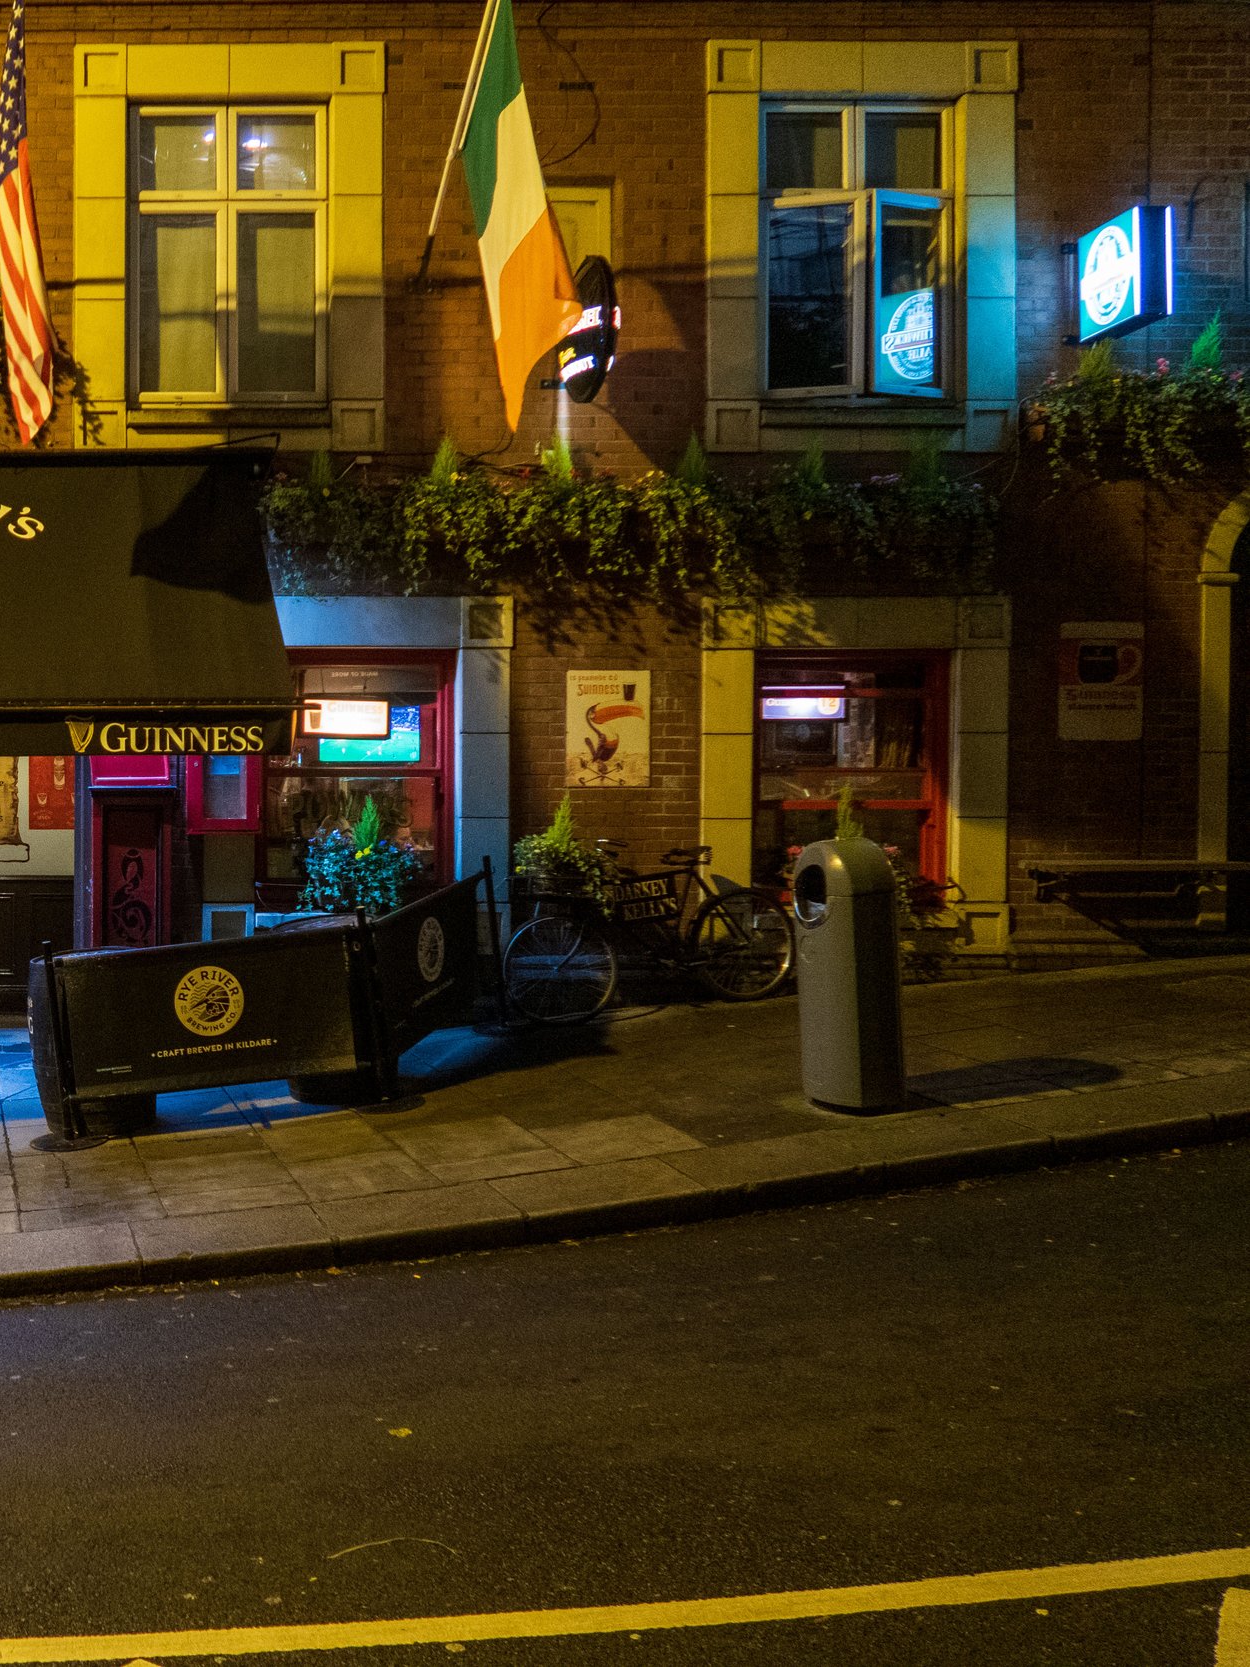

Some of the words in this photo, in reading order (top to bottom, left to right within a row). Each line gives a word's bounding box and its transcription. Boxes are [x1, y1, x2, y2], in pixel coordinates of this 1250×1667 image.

[99, 722, 264, 753] GUINNESS
[177, 975, 199, 1001] RYE
[200, 970, 239, 997] RIVER
[186, 1016, 225, 1033] BREWING
[156, 1048, 185, 1058] CRAFT
[186, 1044, 223, 1055] BREWED
[224, 1042, 234, 1051] IN
[236, 1038, 272, 1049] KILDARE
